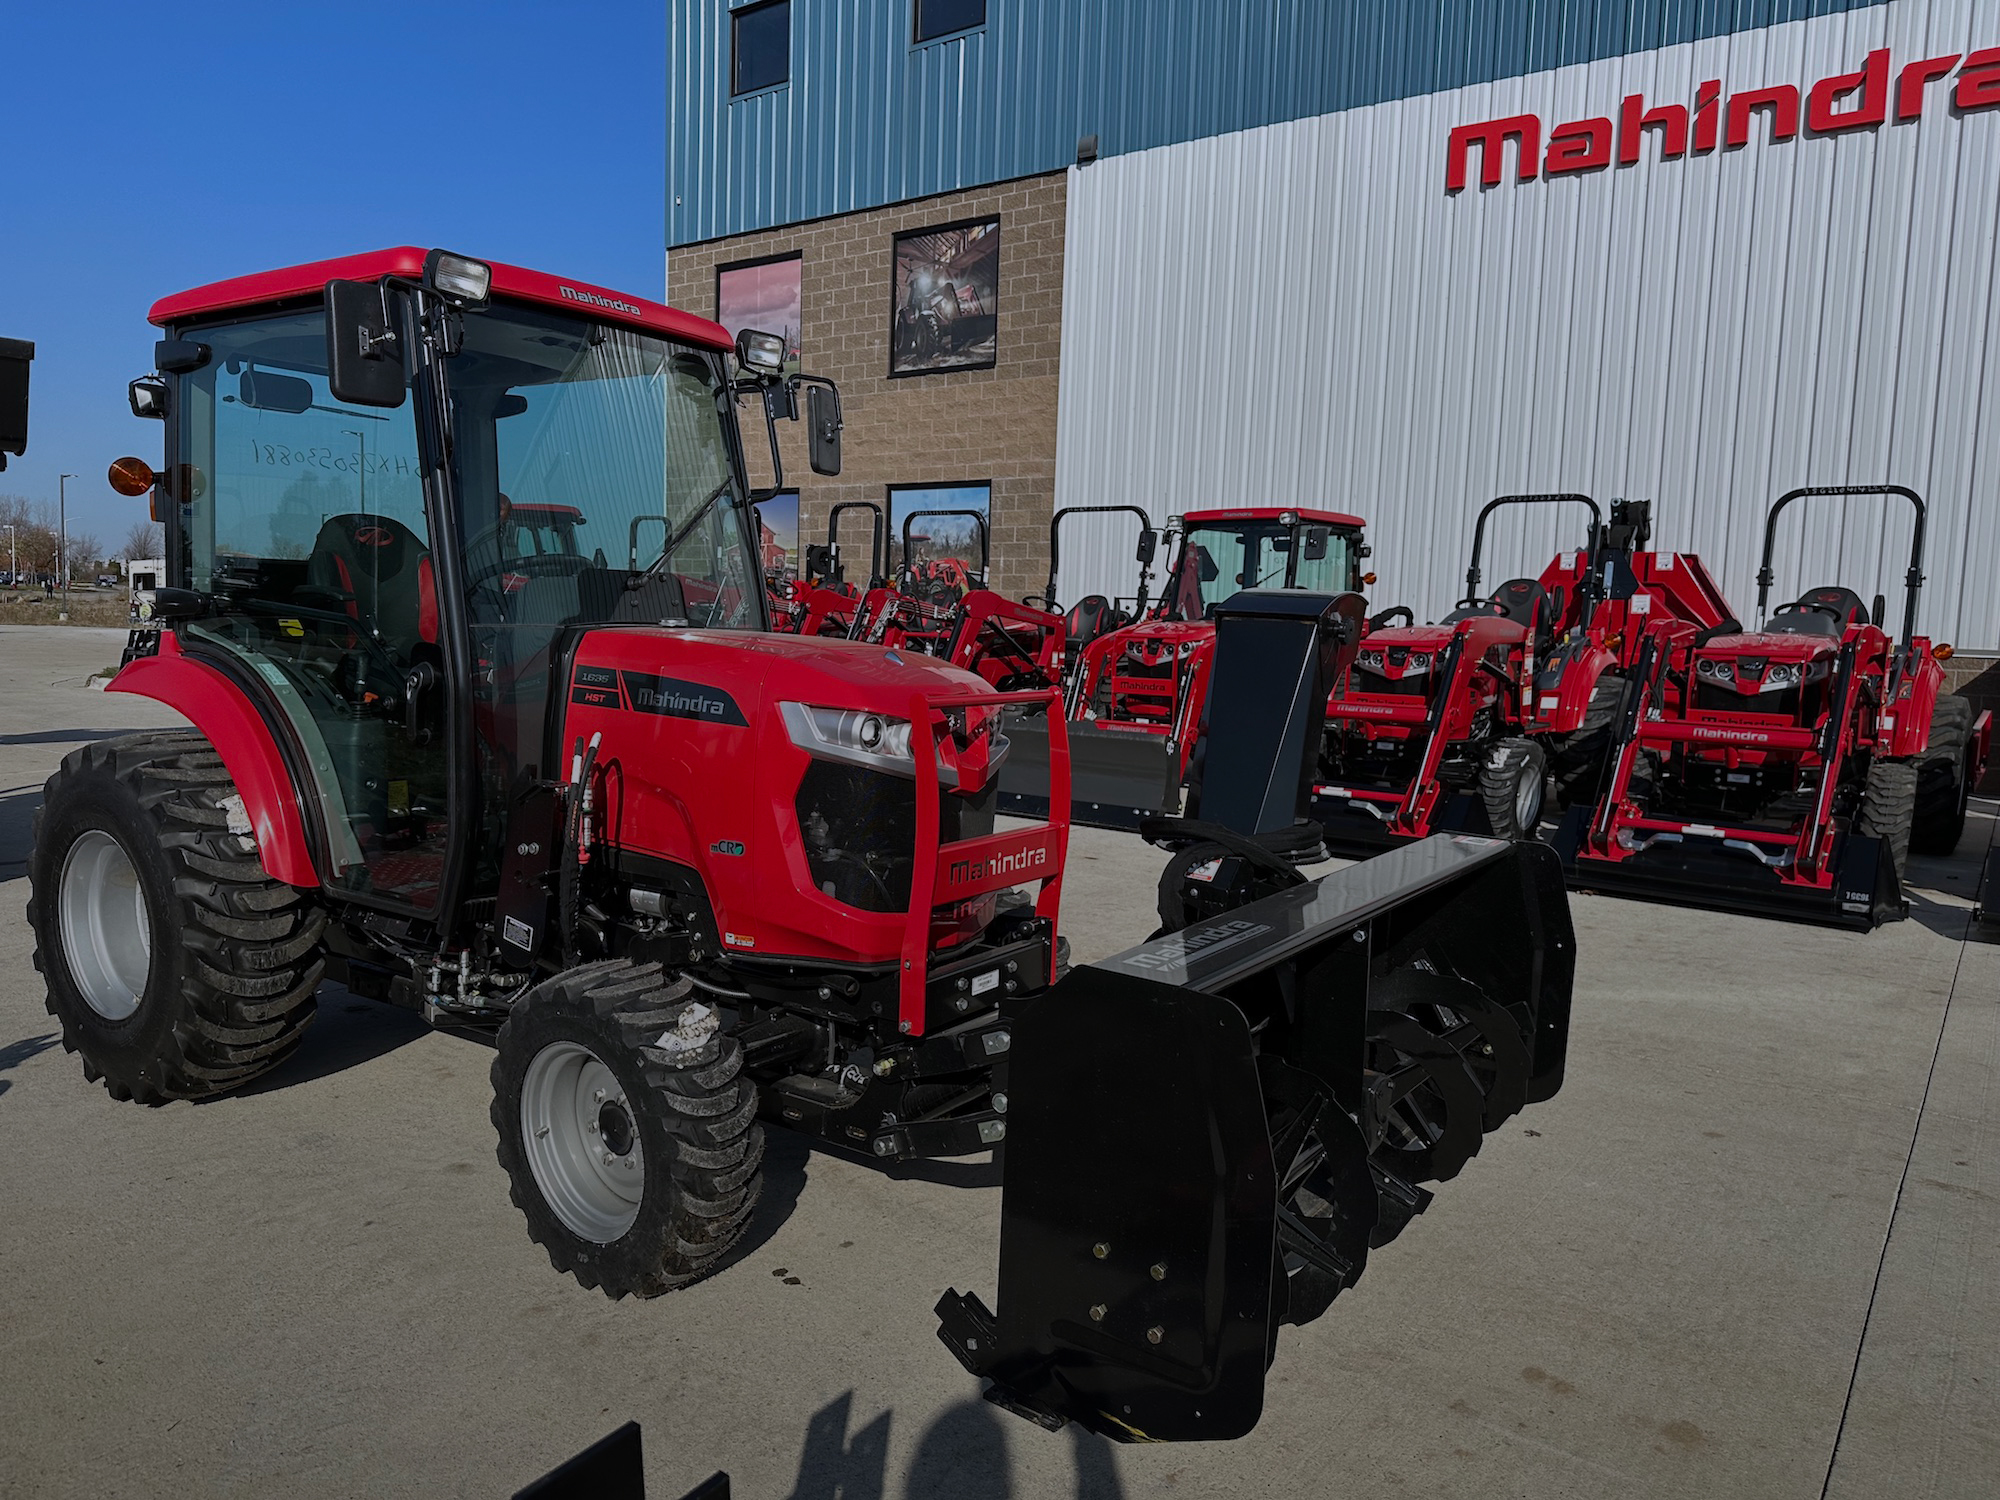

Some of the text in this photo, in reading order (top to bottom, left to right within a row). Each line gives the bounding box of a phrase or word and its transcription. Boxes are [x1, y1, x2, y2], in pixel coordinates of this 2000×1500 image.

[559, 285, 641, 315] Mahindra
[1120, 681, 1166, 691] Mahindra
[585, 693, 606, 703] HST
[637, 687, 725, 715] Mahindra
[1337, 704, 1393, 714] Mahindra
[1693, 727, 1768, 741] Mahindra
[950, 846, 1046, 886] Mahindra
[1122, 920, 1255, 968] Mahindra
